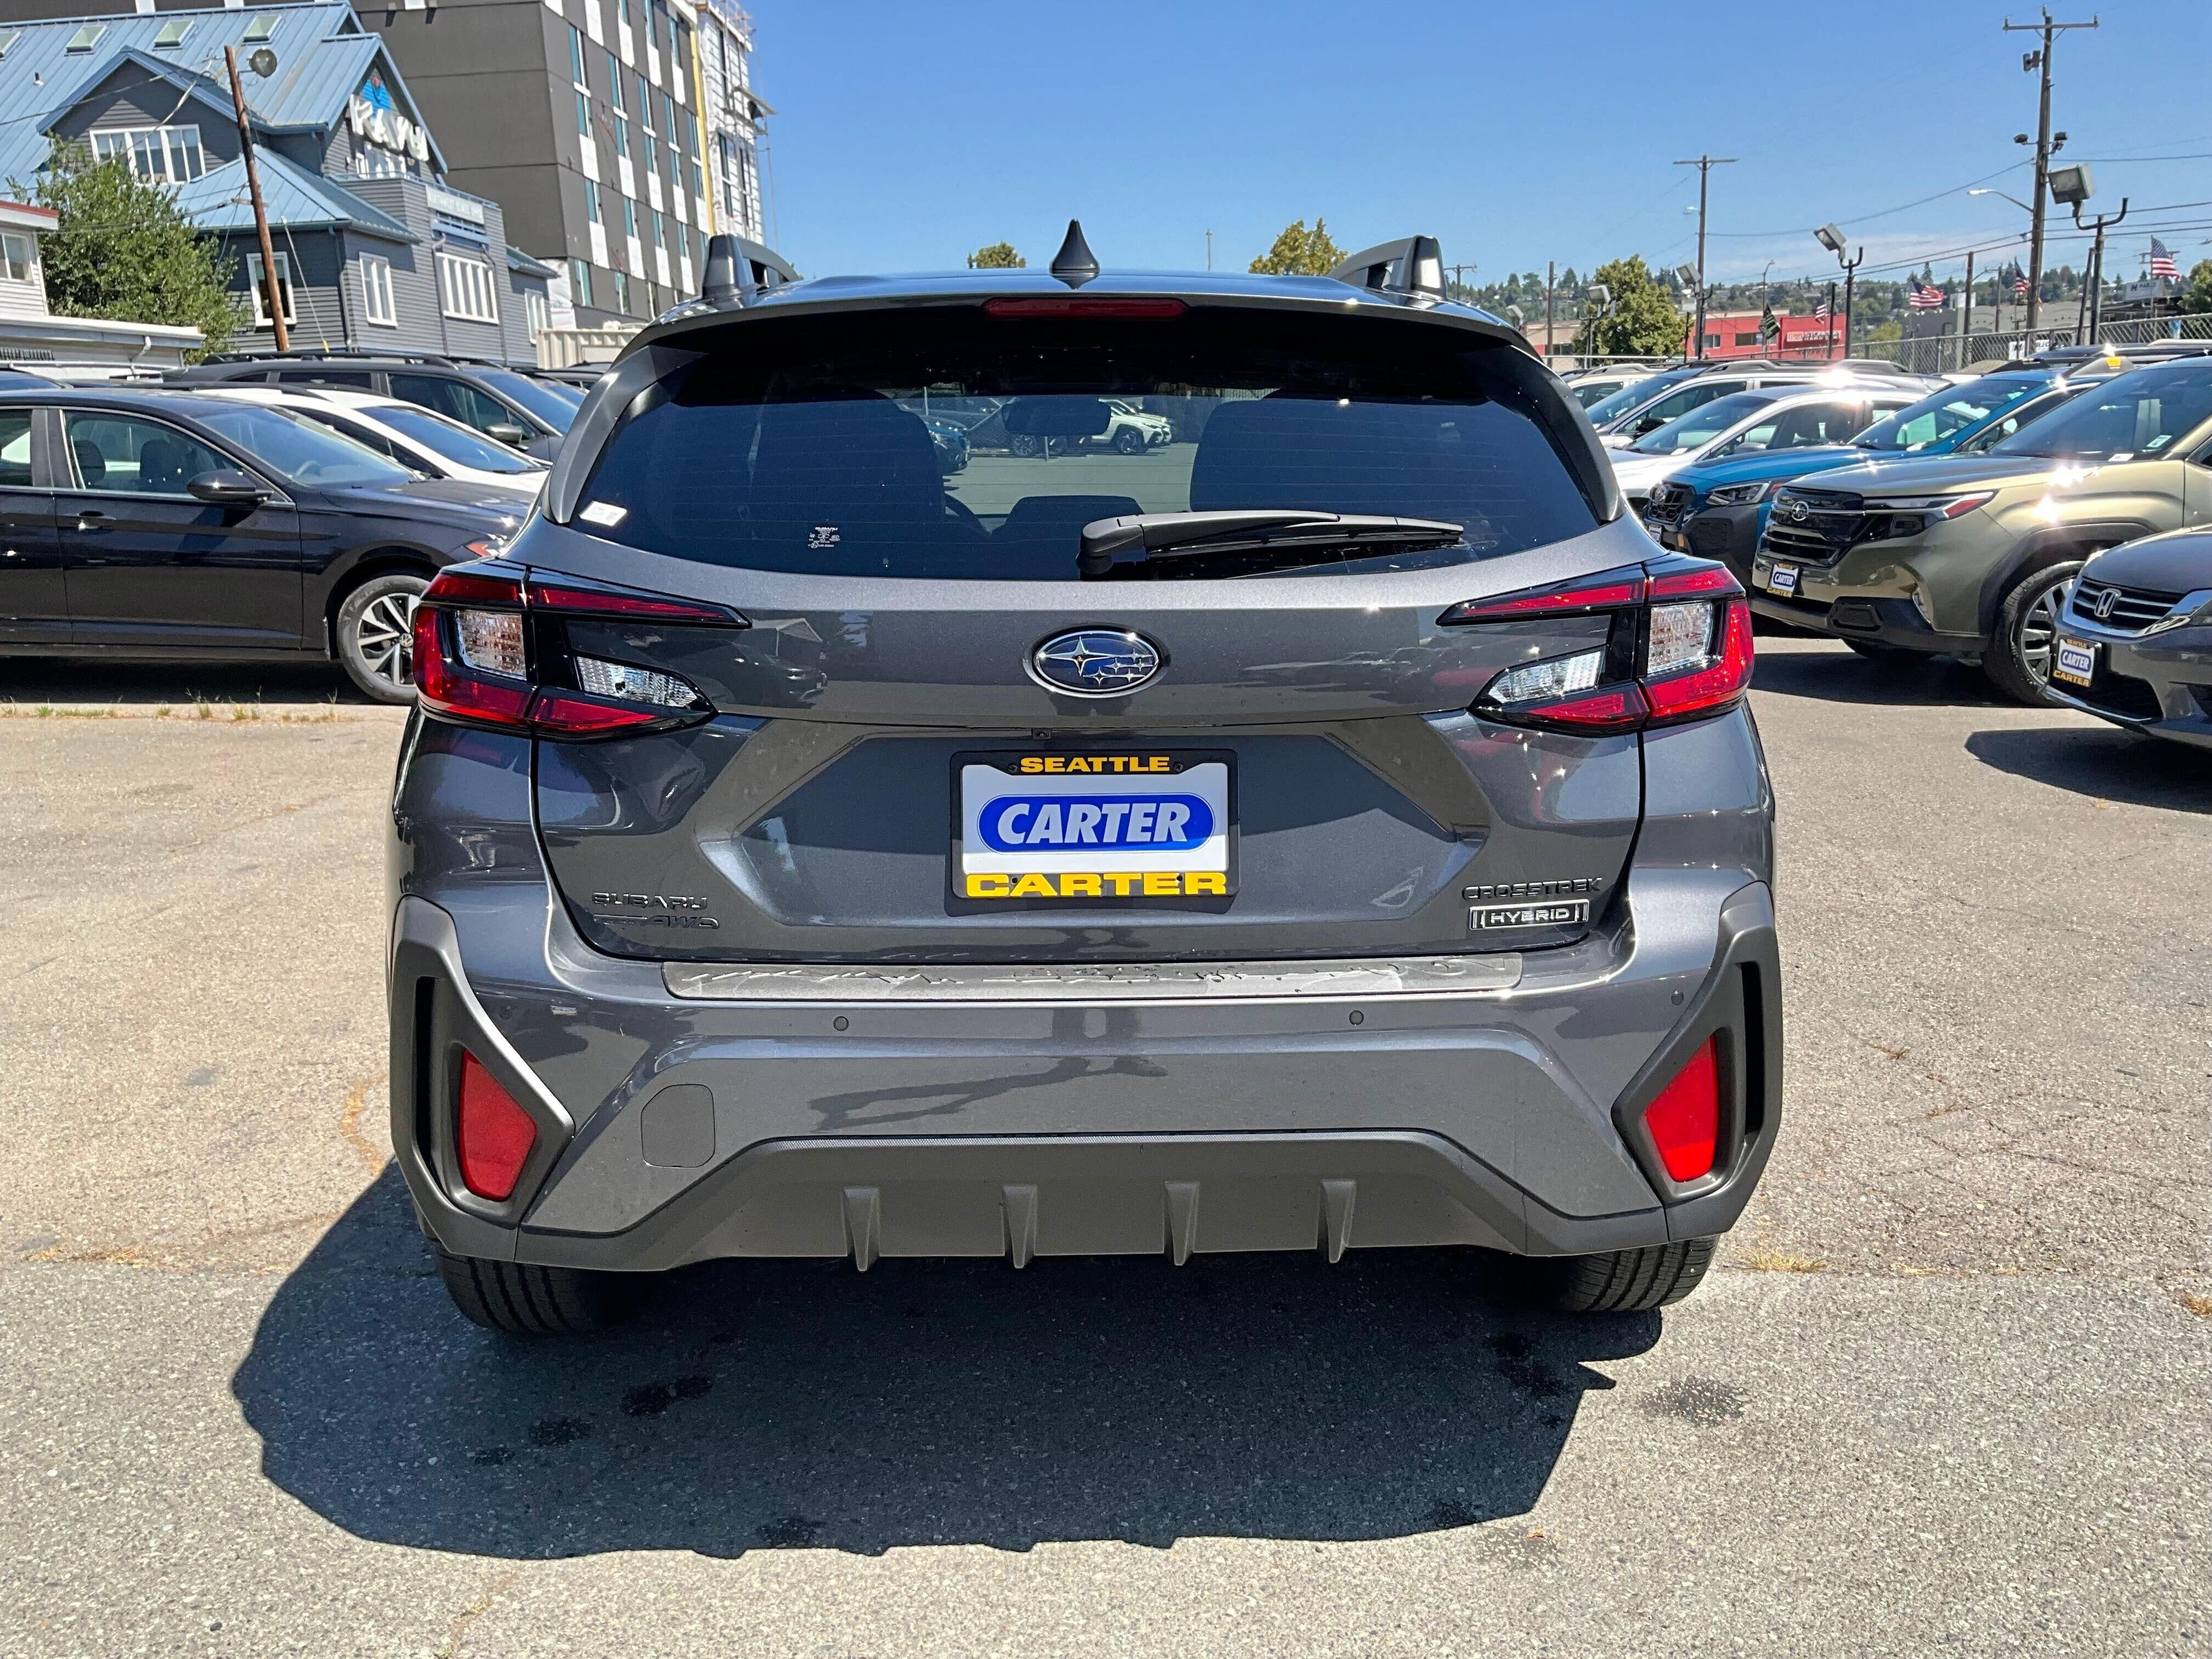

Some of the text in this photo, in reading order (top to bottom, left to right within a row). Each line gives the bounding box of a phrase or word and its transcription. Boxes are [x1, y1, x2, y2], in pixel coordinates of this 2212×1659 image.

[1774, 573, 1794, 585] CARTER
[2062, 651, 2090, 669] CARTER
[2053, 670, 2090, 687] CARTER
[1020, 757, 1170, 772] SEATTLE
[997, 803, 1190, 844] CARTER
[967, 872, 1226, 897] CARTER
[1462, 877, 1602, 900] CROSSTREK
[592, 892, 708, 910] SUBARU
[641, 915, 719, 929] AWD
[1490, 908, 1570, 923] HYBRID
